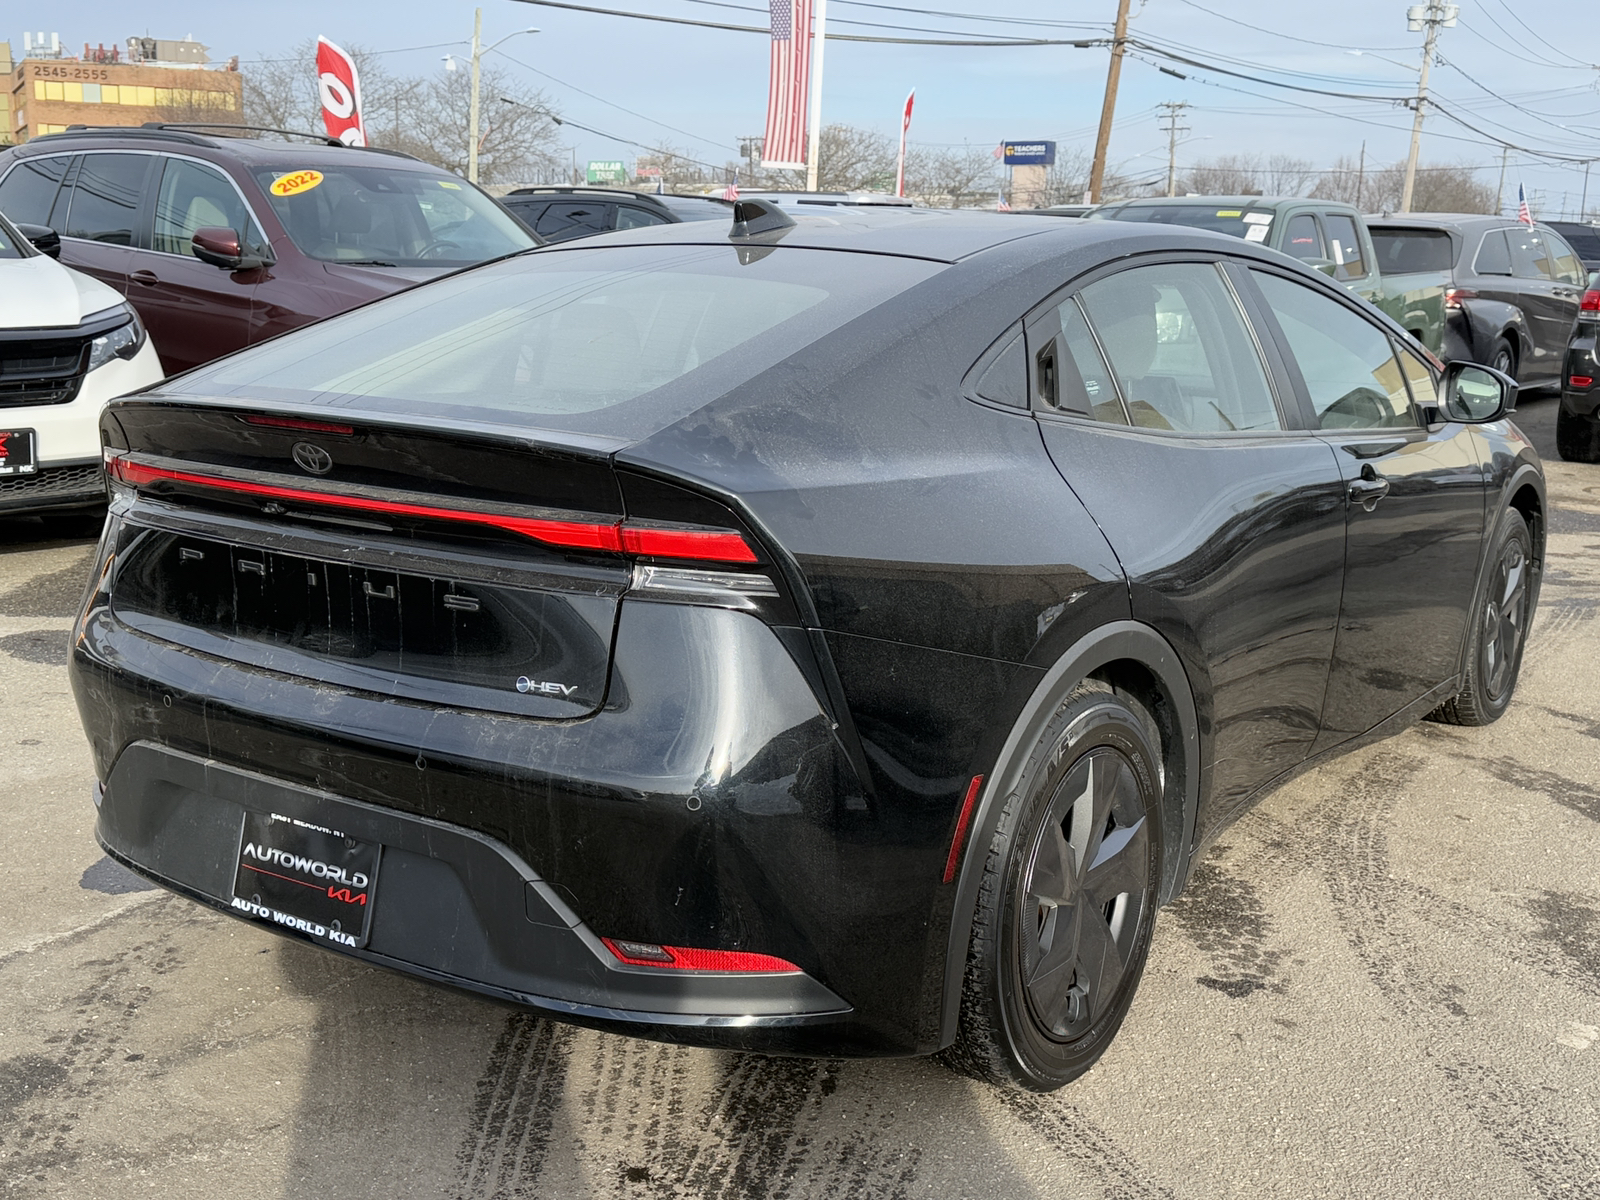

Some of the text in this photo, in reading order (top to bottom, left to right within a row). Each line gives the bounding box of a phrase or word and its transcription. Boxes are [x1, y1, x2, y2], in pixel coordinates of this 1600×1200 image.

[34, 66, 108, 80] 2545-2555
[590, 162, 621, 171] DOLLAR
[277, 171, 319, 193] 2022
[179, 547, 479, 611] PRIUS
[530, 679, 579, 696] HEV
[243, 843, 368, 888] AUTOWORLD
[327, 885, 367, 906] KIA
[231, 897, 357, 948] AUTO WORLD KIA
